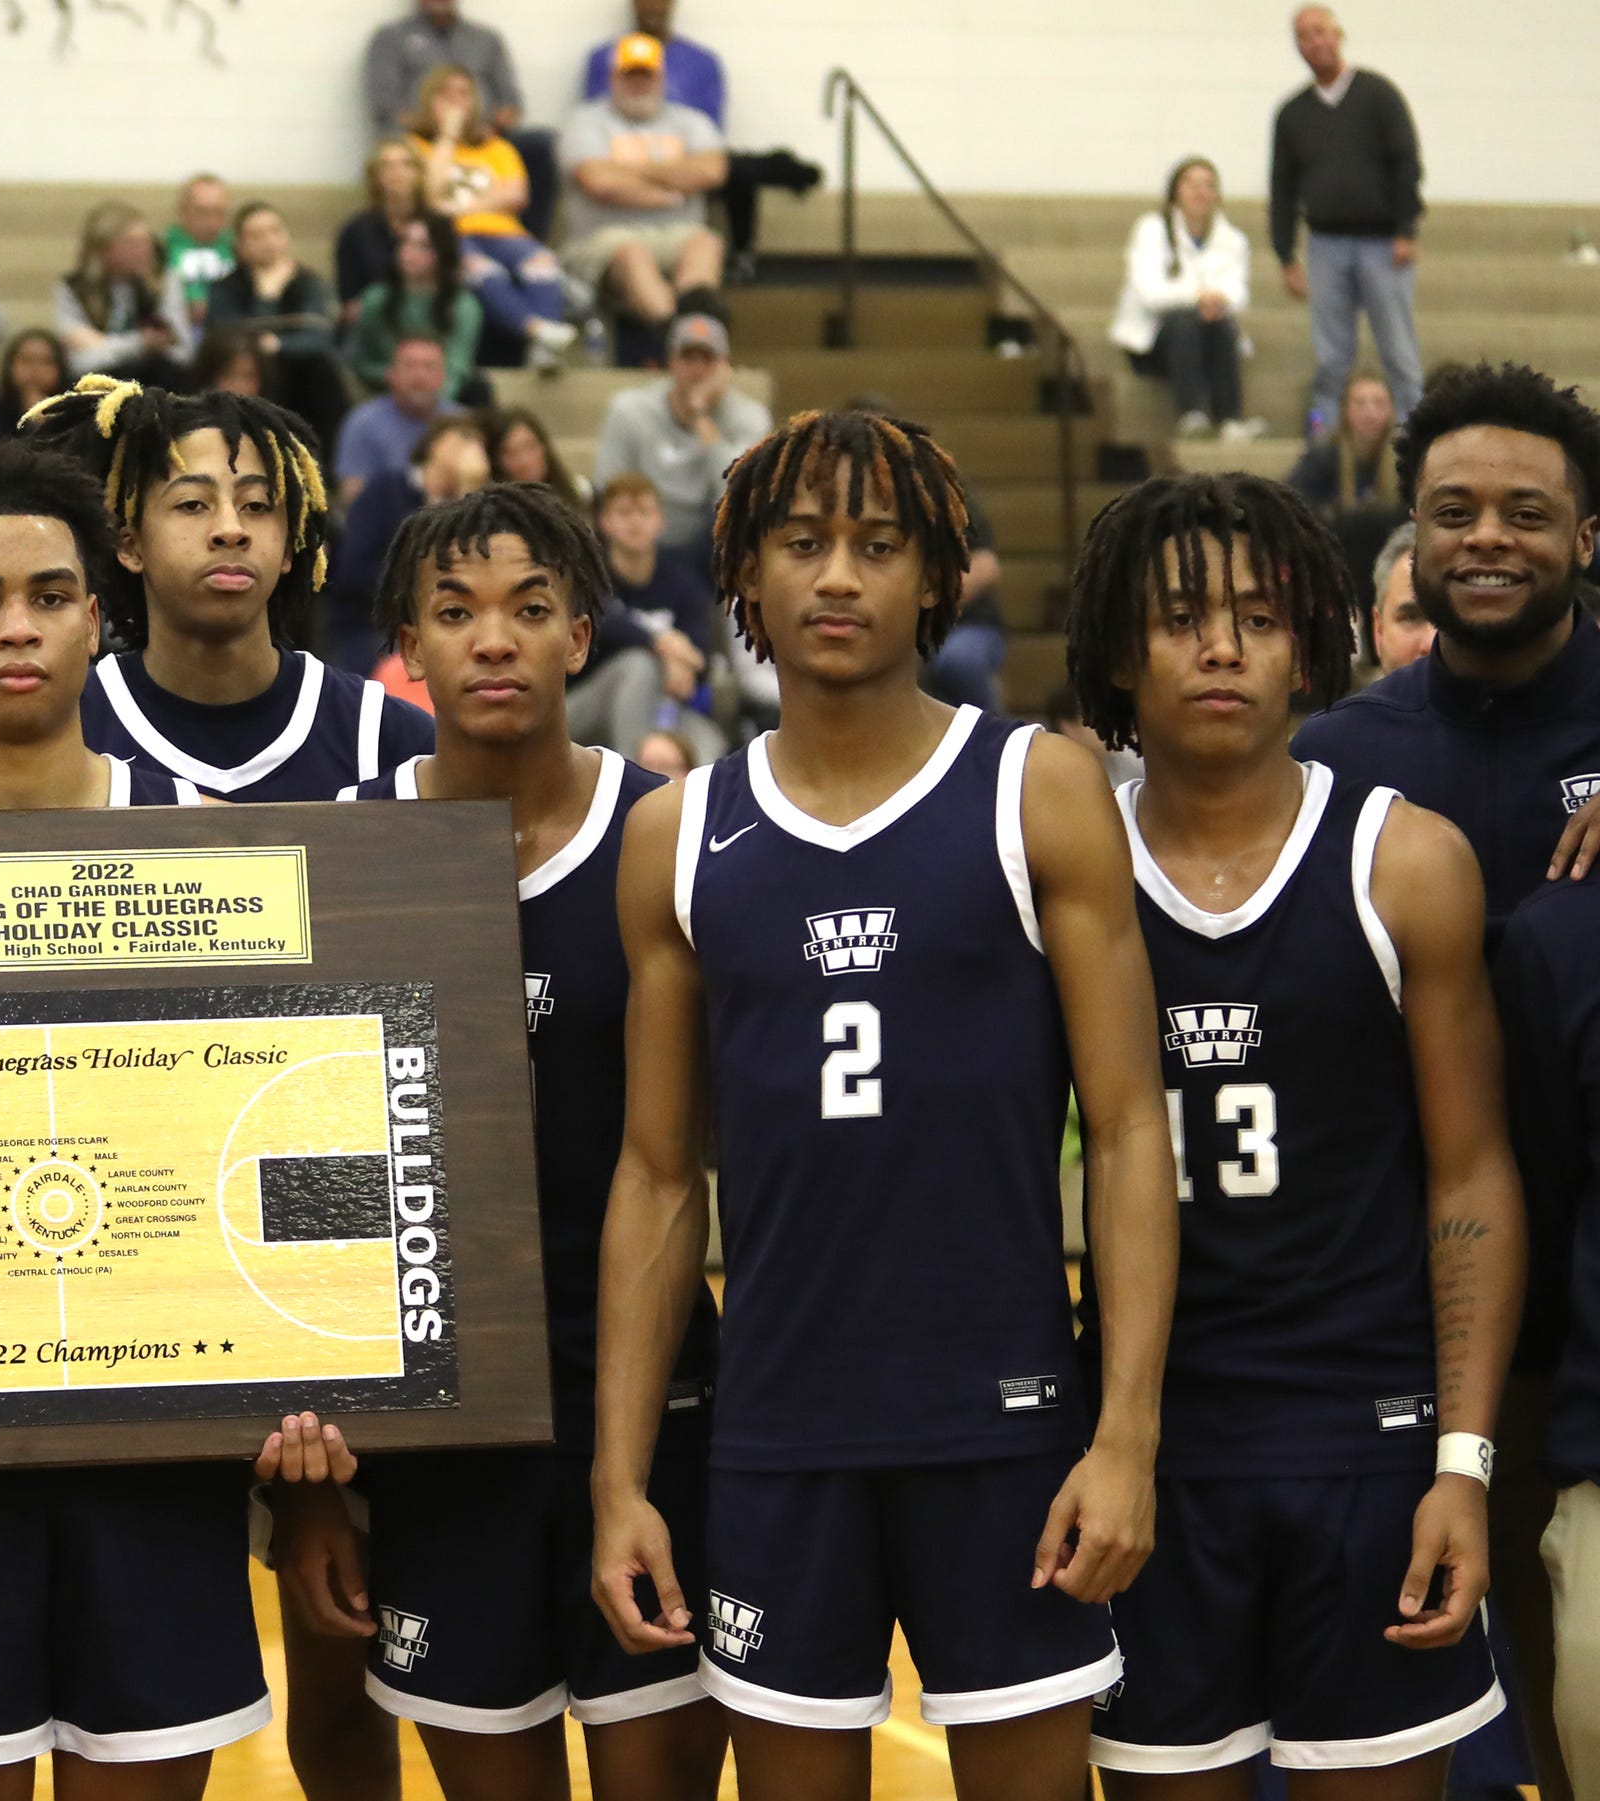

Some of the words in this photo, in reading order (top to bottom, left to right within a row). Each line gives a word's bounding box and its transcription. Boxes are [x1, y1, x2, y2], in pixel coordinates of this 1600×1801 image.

[72, 863, 134, 880] 2022
[11, 885, 62, 898] CHAD
[68, 883, 156, 897] GARDNER
[163, 882, 202, 895] LAW
[16, 902, 48, 919] OF
[57, 901, 106, 918] THE
[115, 896, 264, 917] BLUEGRASS
[112, 919, 218, 938] CLASSIC
[5, 943, 41, 958] High
[47, 942, 103, 955] School
[129, 940, 203, 953] Fairdale,
[209, 937, 286, 951] Kentucky
[809, 935, 891, 955] CENTRAL
[1171, 1030, 1255, 1046] CENTRAL
[82, 1047, 194, 1071] Holiday
[204, 1043, 288, 1068] Classic
[821, 1000, 882, 1119] 2
[38, 1137, 76, 1146] ROGERS
[78, 1136, 109, 1145] CLARK
[94, 1152, 118, 1160] MALE
[108, 1170, 137, 1178] LARUE
[139, 1168, 175, 1177] COUNTY
[27, 1172, 85, 1195] FAIRDALE
[114, 1185, 150, 1193] HARLAN
[152, 1183, 188, 1192] COUNTY
[117, 1199, 168, 1208] WOODFORD
[170, 1198, 206, 1206] COUNTY
[387, 1047, 443, 1343] BULLDOGS
[115, 1216, 144, 1224] GREAT
[146, 1214, 197, 1223] CROSSINGS
[29, 1218, 85, 1240] KENTUCKY
[111, 1231, 141, 1240] NORTH
[143, 1230, 180, 1238] OLDHAM
[98, 1249, 139, 1258] DESALES
[7, 1268, 48, 1277] CENTRAL
[50, 1266, 94, 1276] CATHOLIC
[95, 1265, 113, 1276] (PA)
[37, 1338, 181, 1369] Champions
[1045, 1384, 1056, 1399] M
[1422, 1403, 1434, 1417] M
[710, 1616, 756, 1645] CENTRAL
